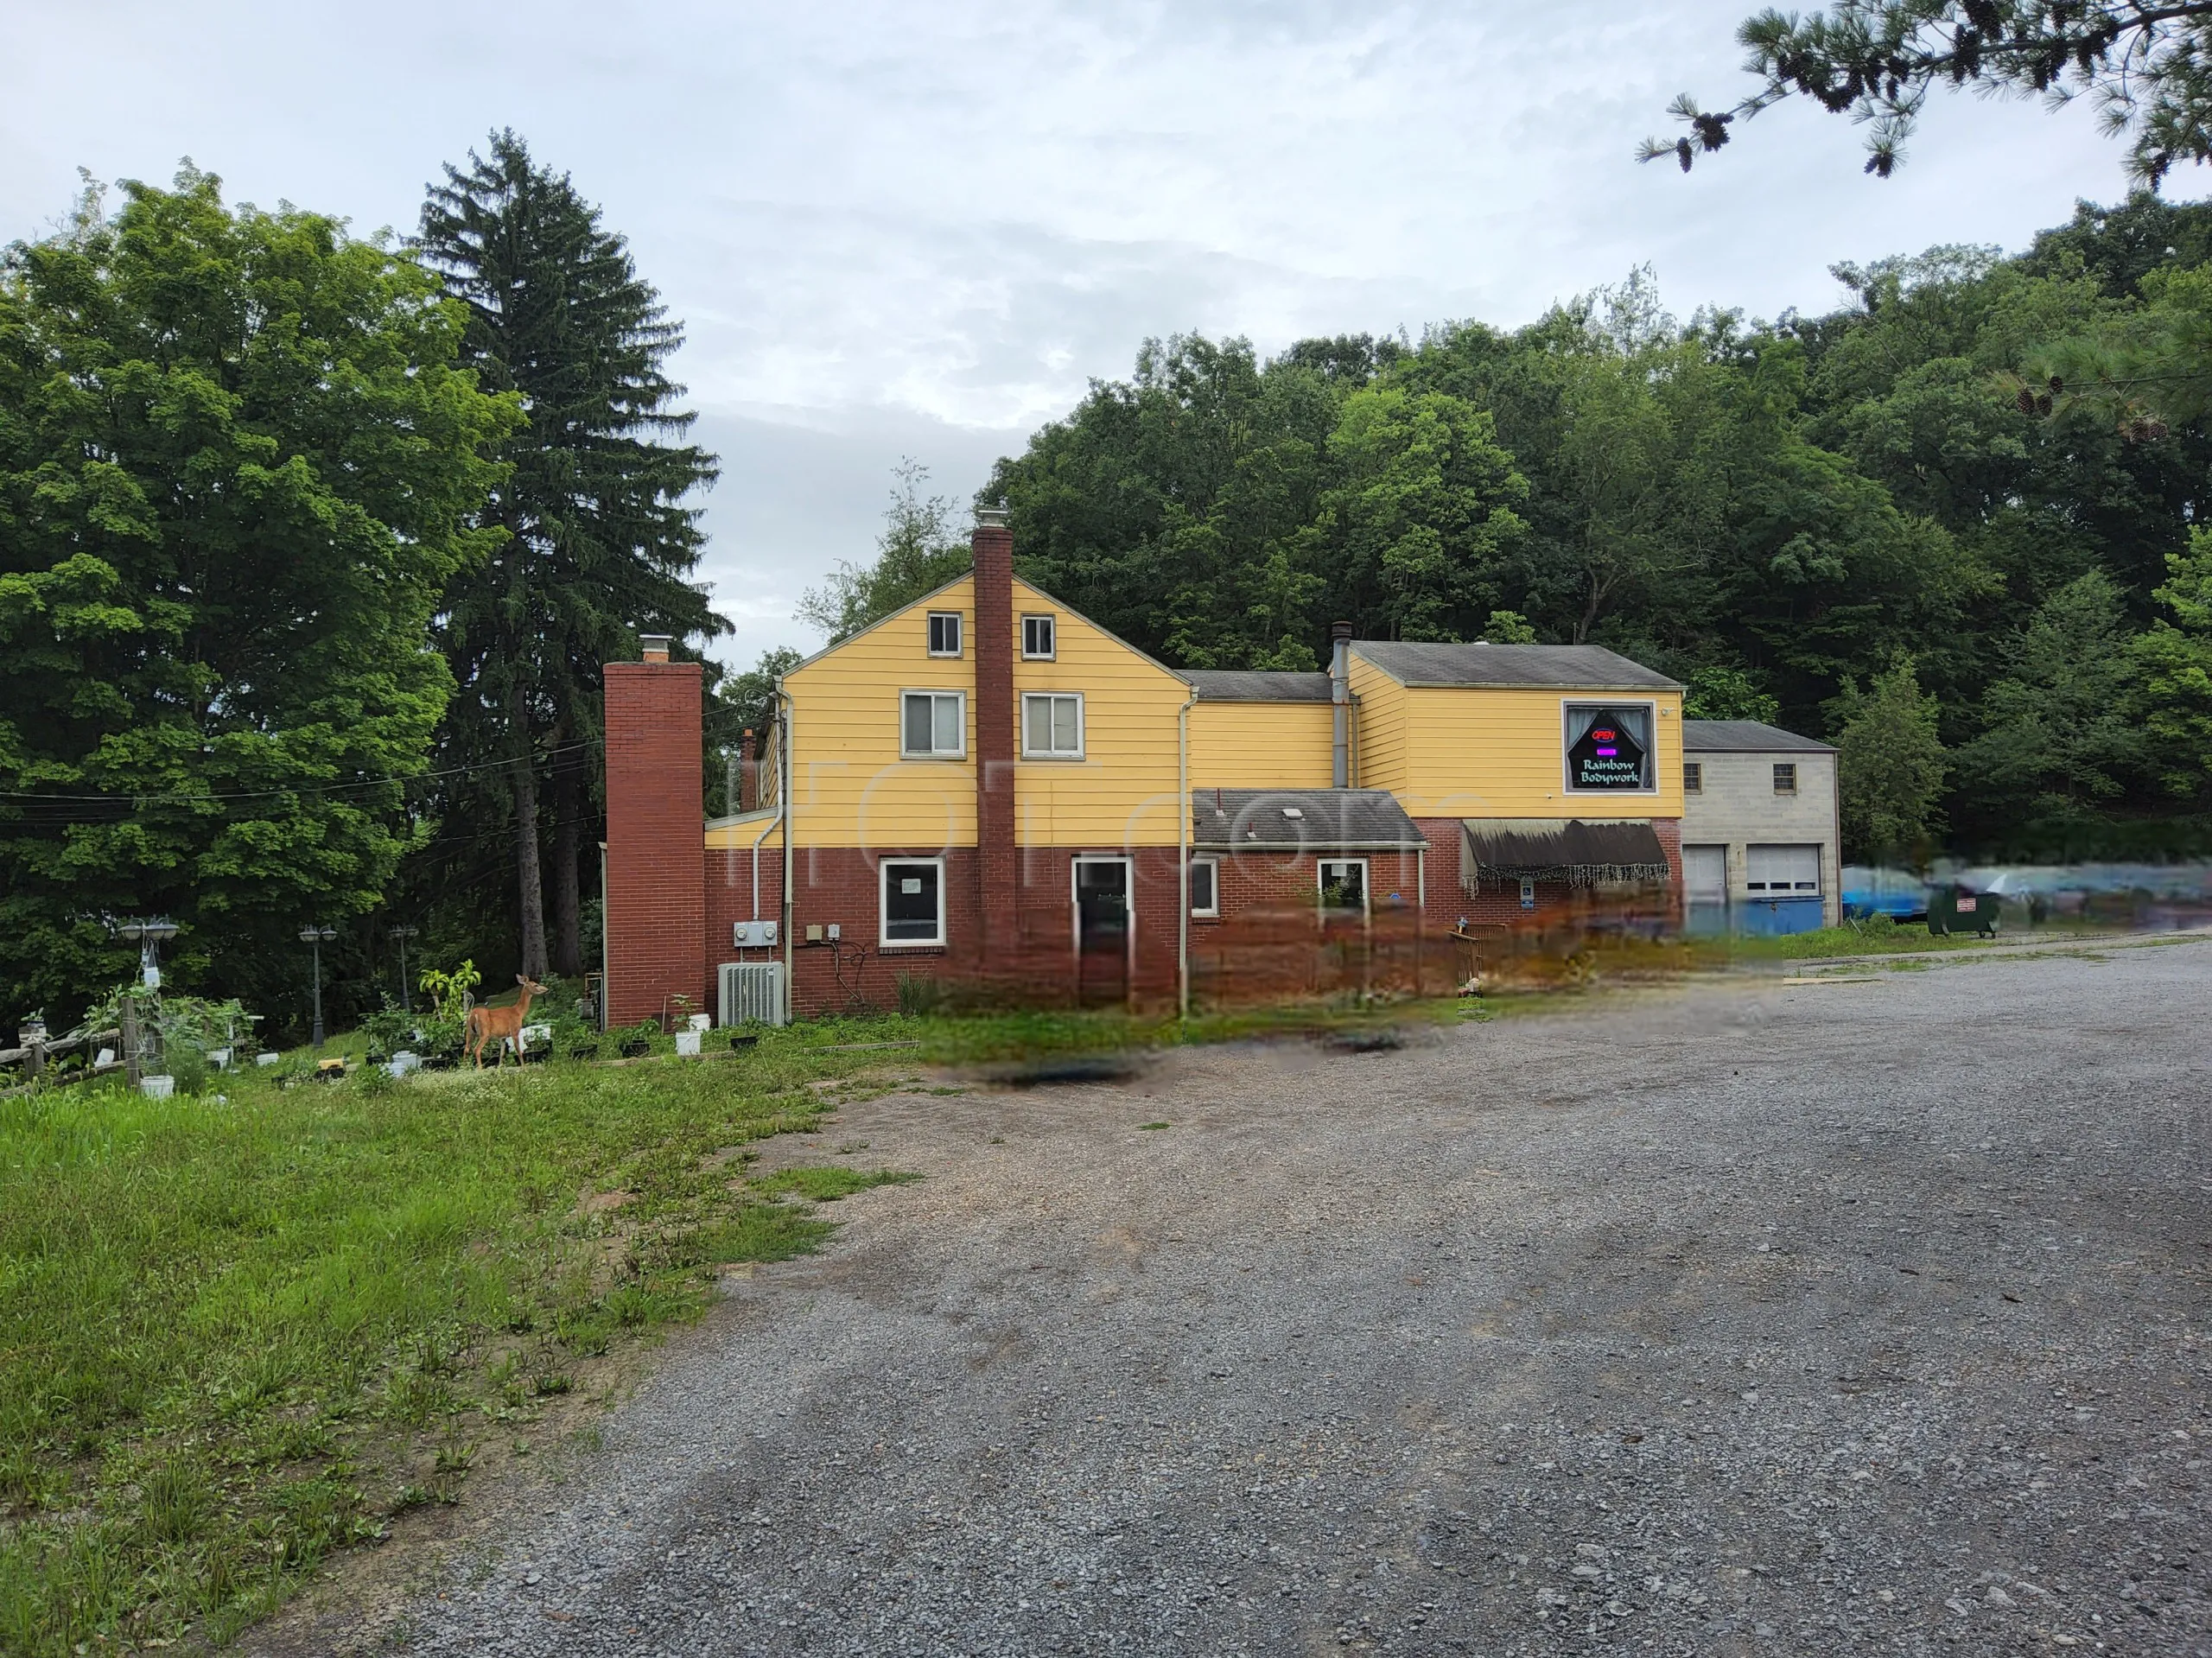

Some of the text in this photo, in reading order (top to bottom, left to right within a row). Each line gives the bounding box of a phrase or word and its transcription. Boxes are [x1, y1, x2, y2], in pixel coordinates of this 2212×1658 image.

[1592, 731, 1616, 740] OPEN
[1583, 759, 1635, 770] Rainbow
[1580, 771, 1639, 785] Bodywork
